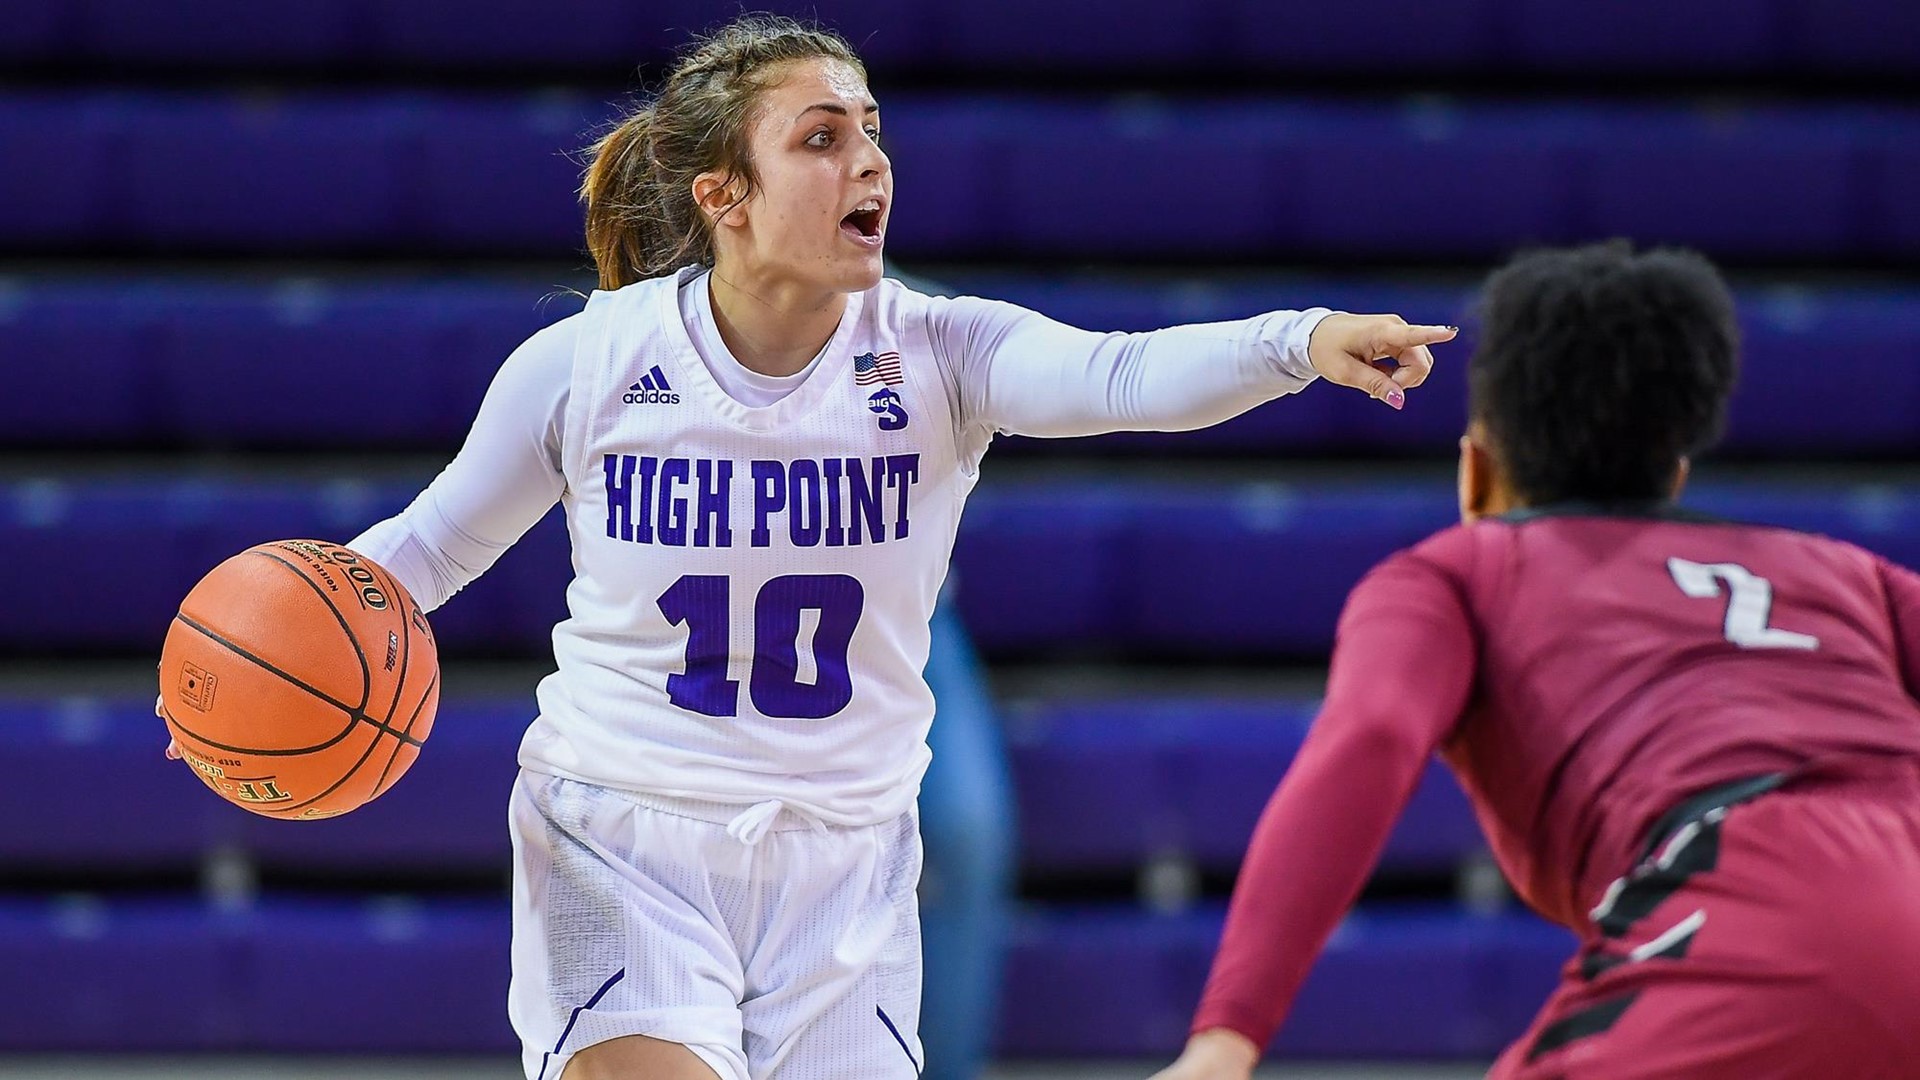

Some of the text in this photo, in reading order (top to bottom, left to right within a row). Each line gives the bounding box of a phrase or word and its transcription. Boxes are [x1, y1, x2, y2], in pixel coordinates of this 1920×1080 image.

[622, 388, 681, 405] adidas
[603, 453, 921, 548] HIGH POINT
[313, 562, 339, 592] DESIGN
[1666, 556, 1820, 650] 2
[655, 574, 865, 719] 10
[218, 758, 242, 767] DEEP
